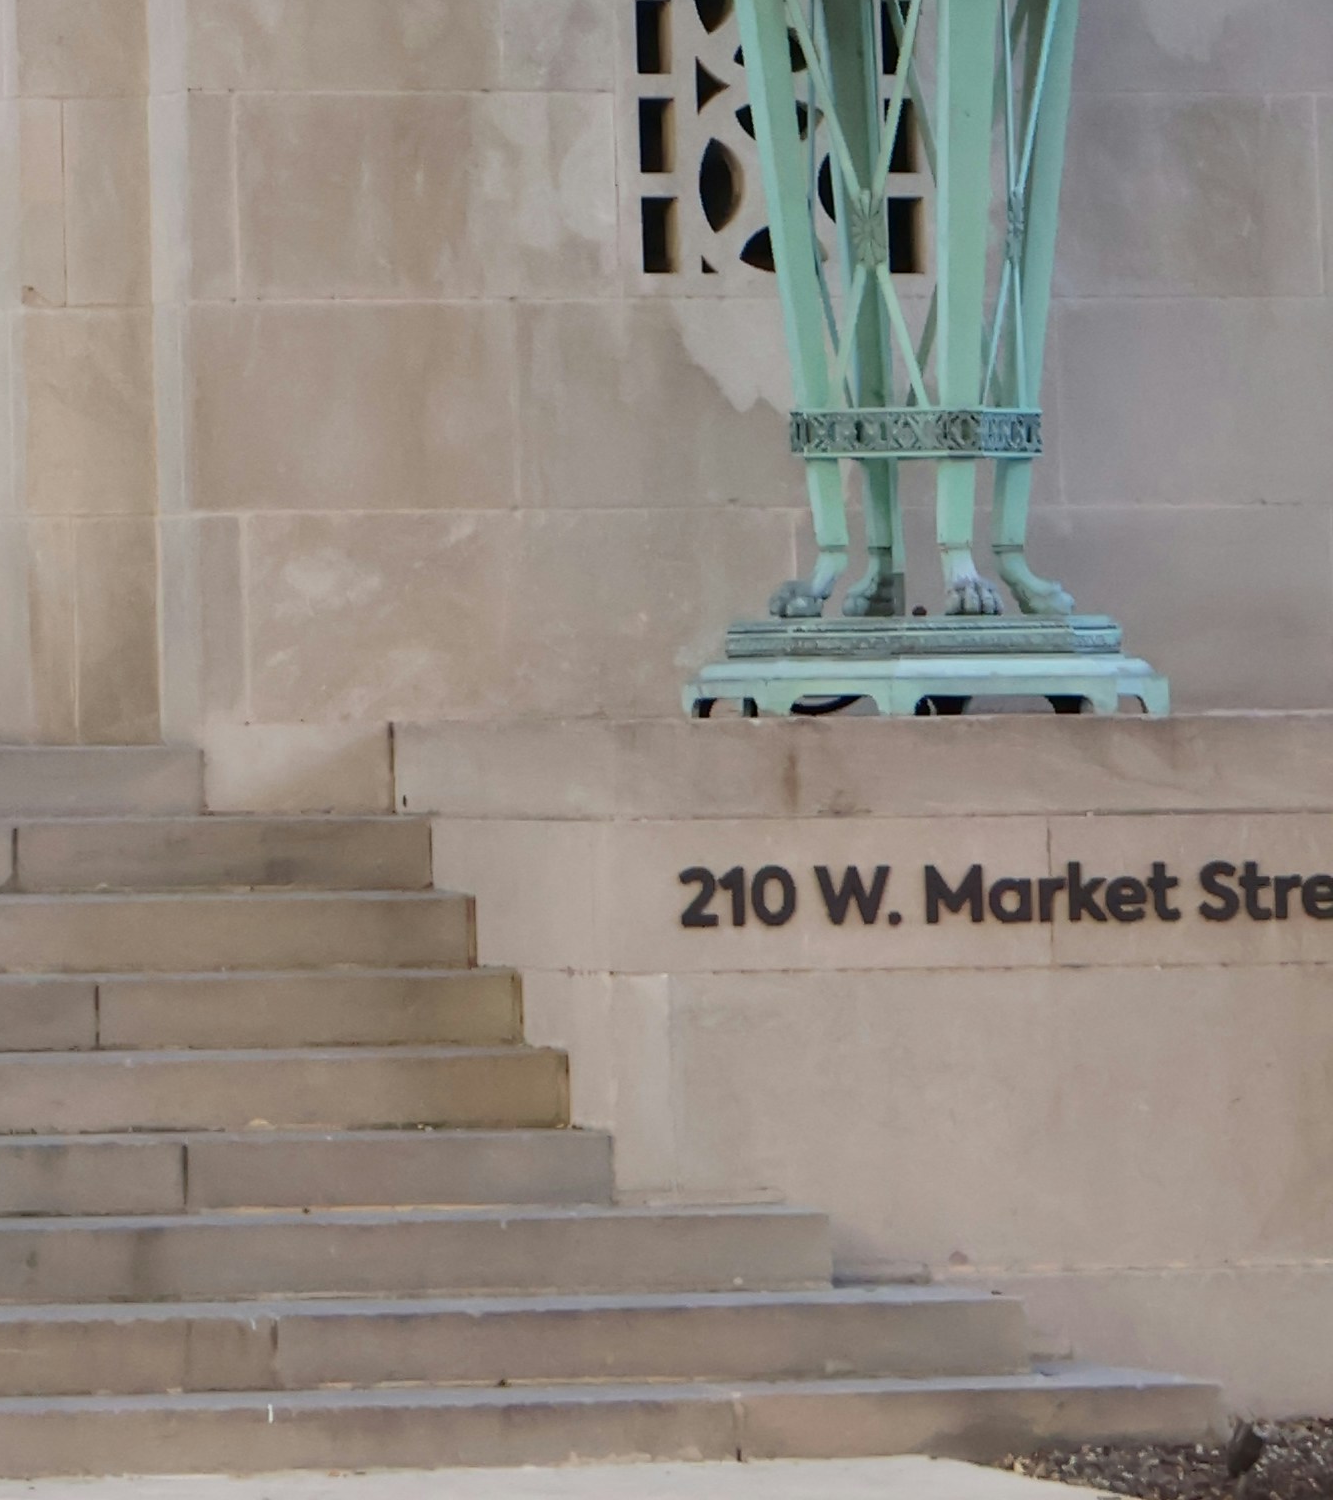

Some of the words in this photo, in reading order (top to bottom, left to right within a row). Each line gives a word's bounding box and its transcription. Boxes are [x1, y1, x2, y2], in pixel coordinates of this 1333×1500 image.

[678, 864, 796, 928] 210
[814, 865, 902, 926] W.
[925, 861, 1182, 924] Market
